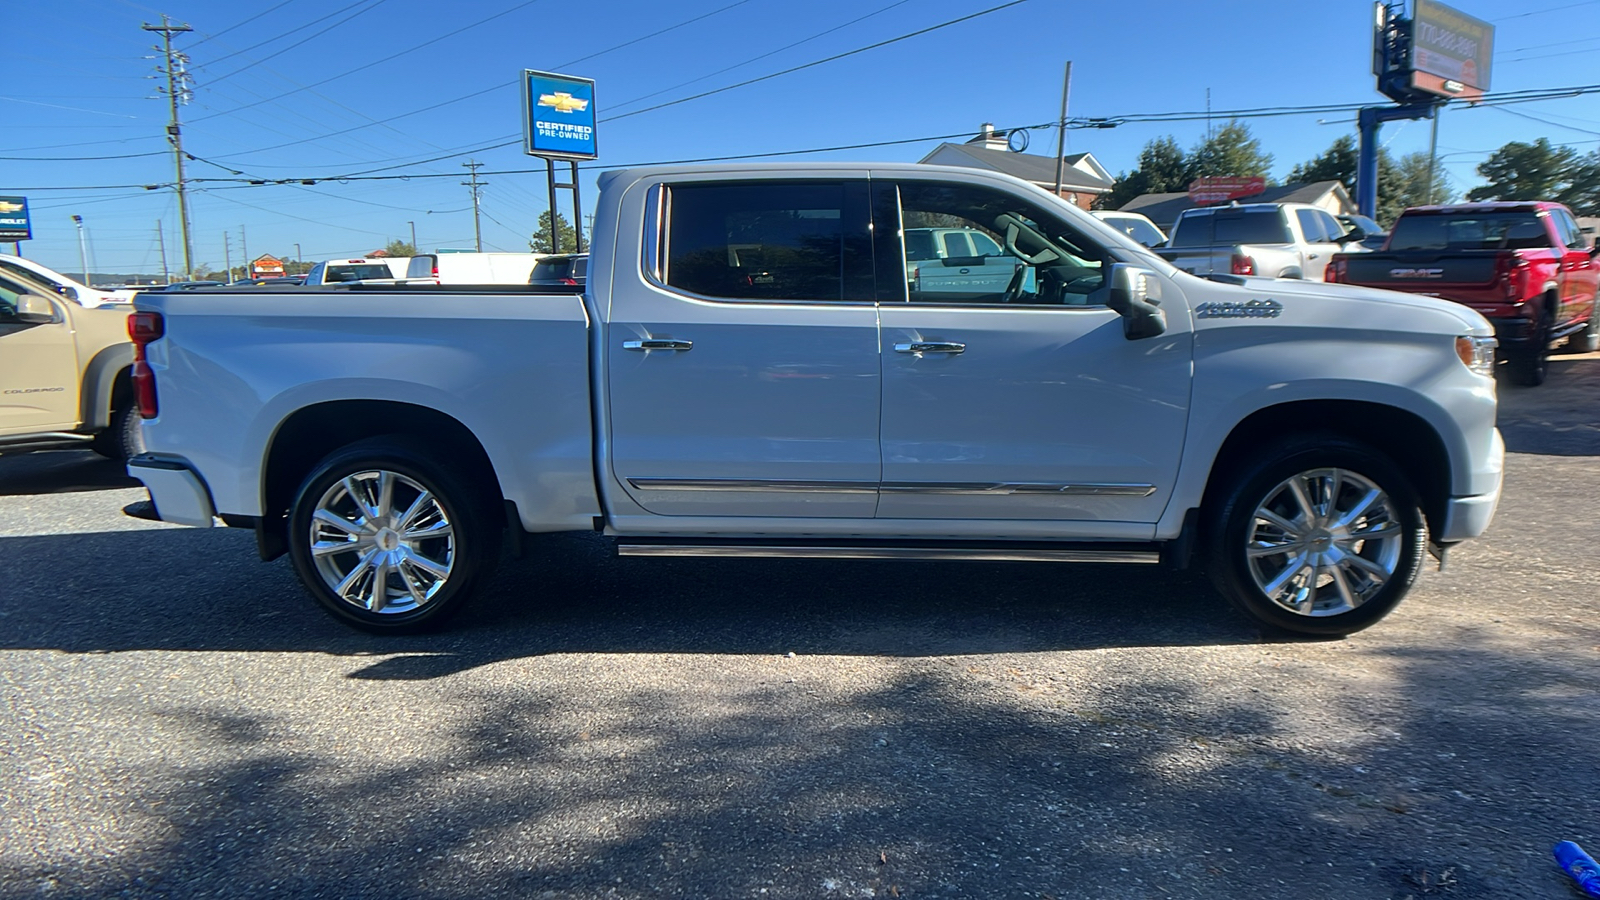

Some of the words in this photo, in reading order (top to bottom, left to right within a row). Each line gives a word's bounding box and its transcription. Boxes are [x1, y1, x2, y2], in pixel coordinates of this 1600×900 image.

[536, 121, 592, 134] CERTIFIED
[539, 129, 590, 141] PRE-OWNED
[1389, 269, 1443, 278] GMC
